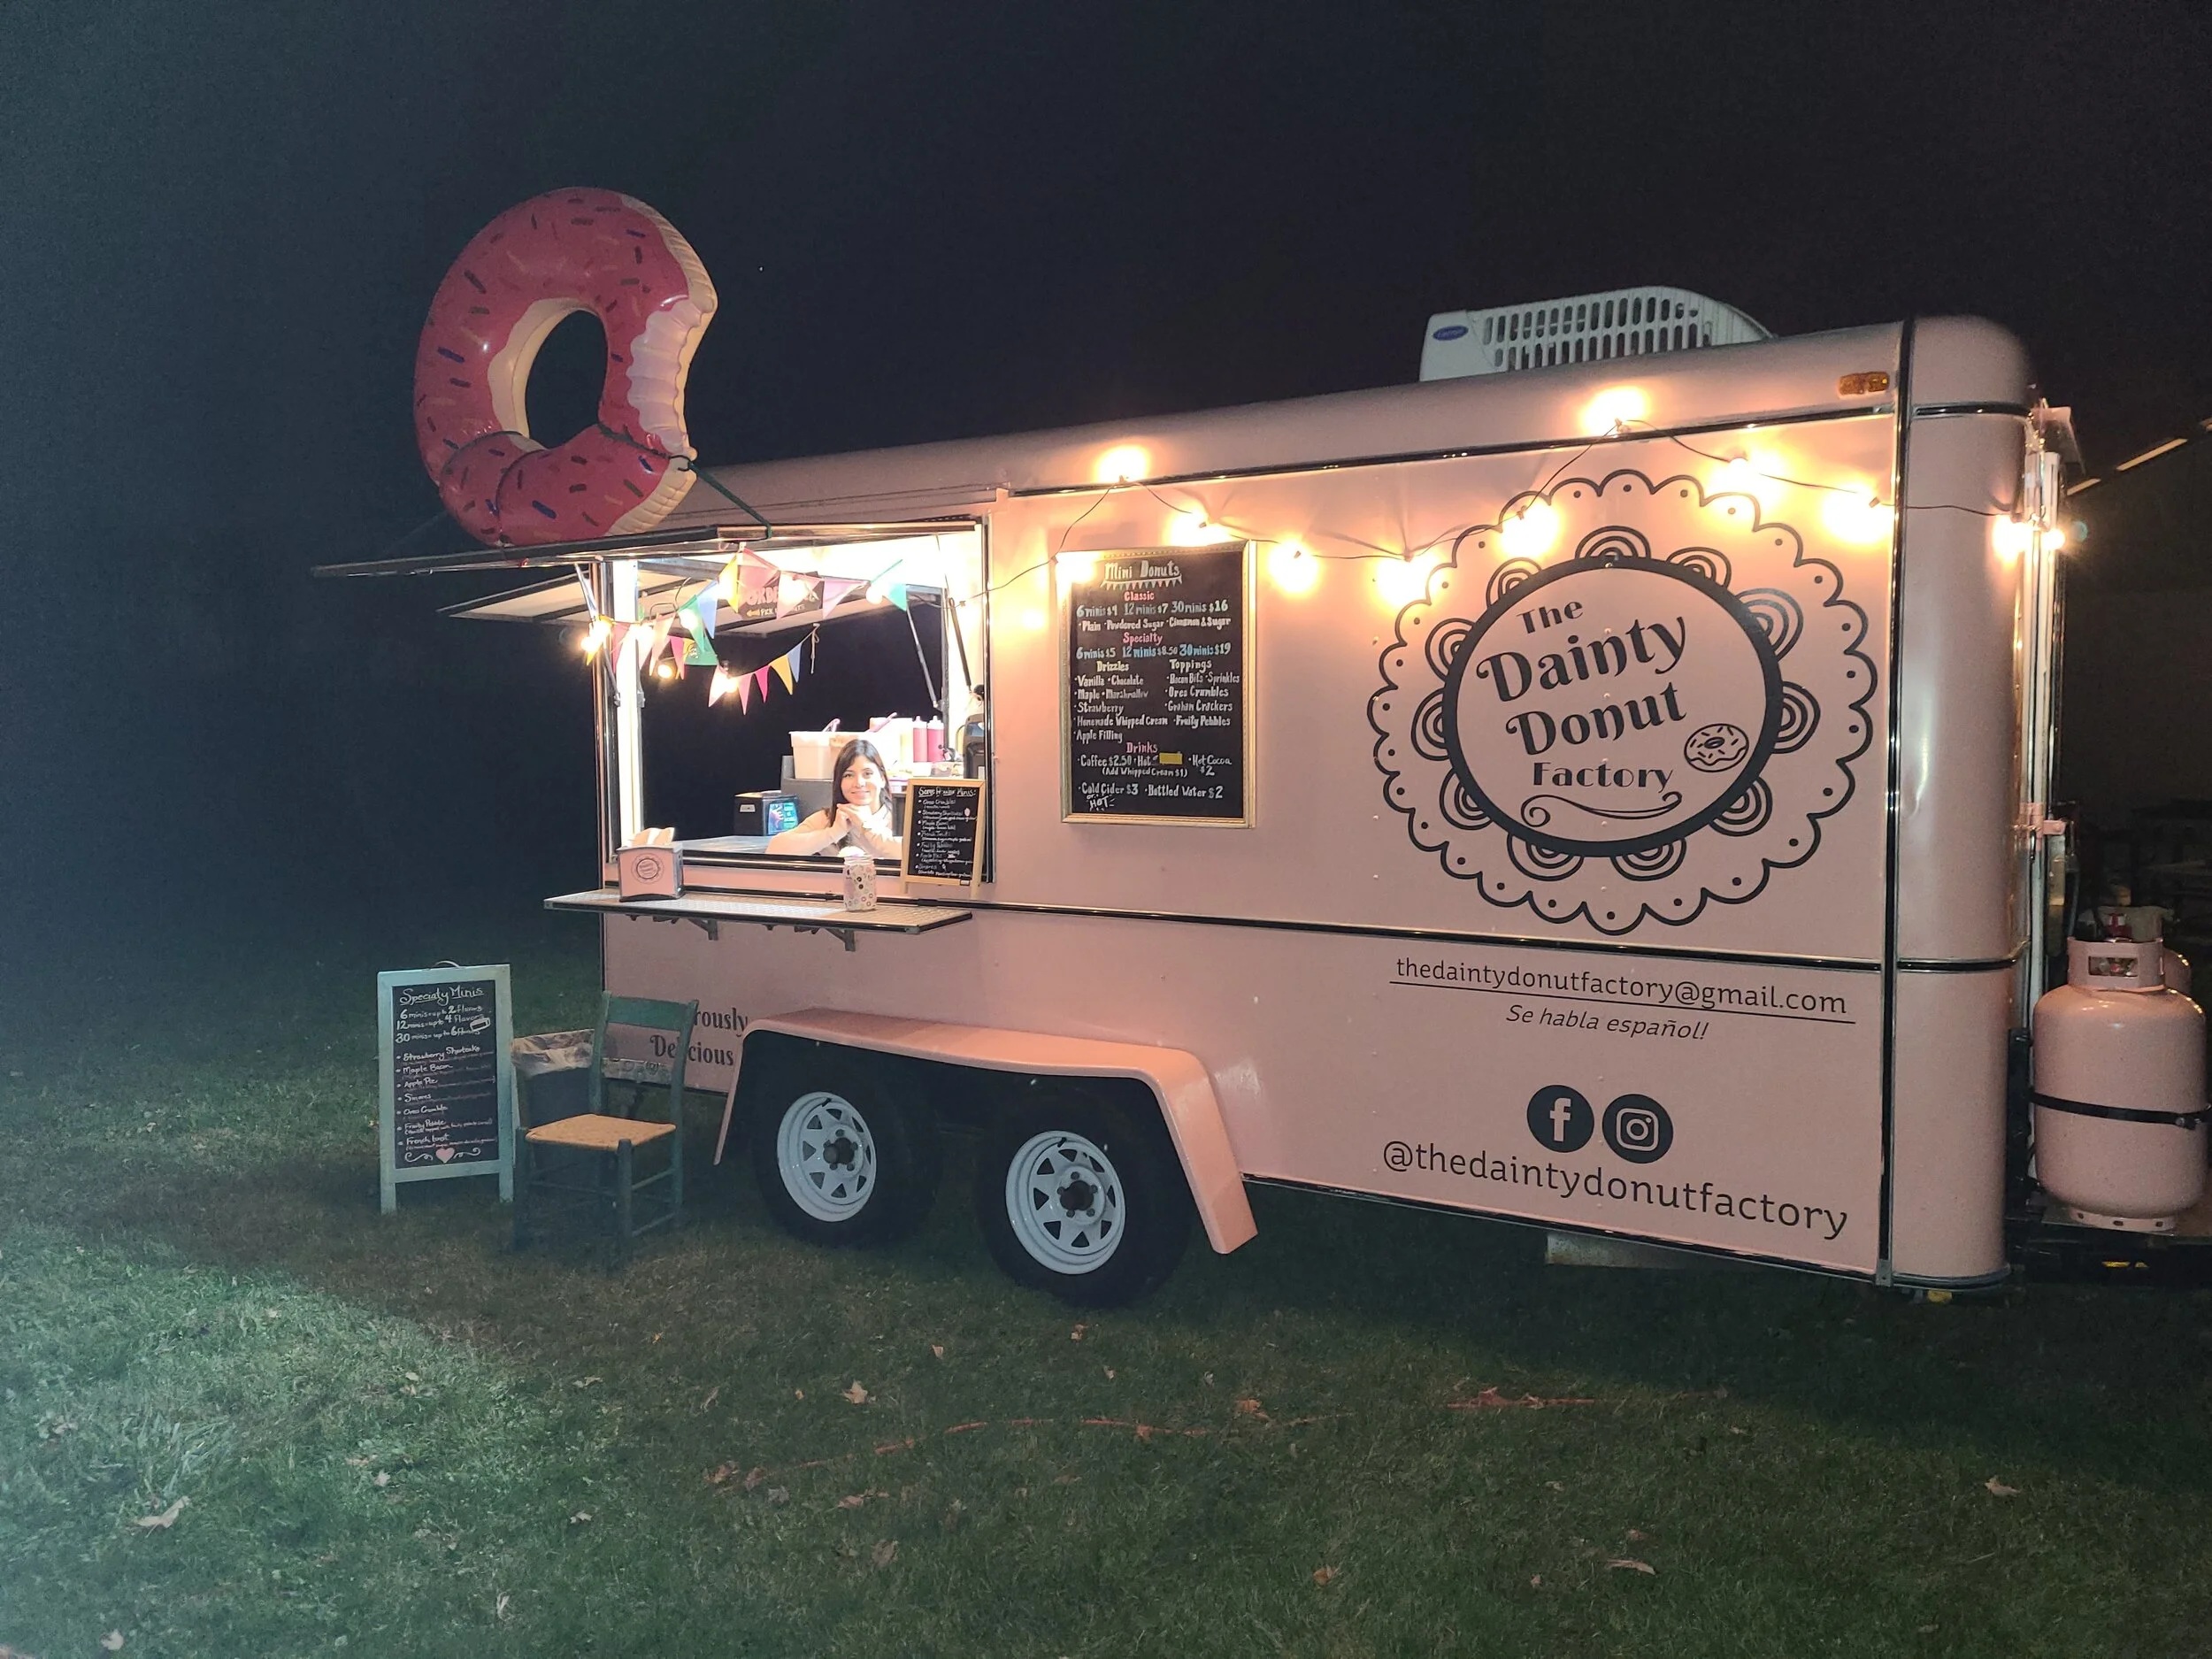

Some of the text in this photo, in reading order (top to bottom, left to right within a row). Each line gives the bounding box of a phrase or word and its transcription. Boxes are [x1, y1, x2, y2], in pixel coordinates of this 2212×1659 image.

[1105, 560, 1180, 580] Mini Donuts
[1124, 591, 1155, 602] Classic
[1209, 599, 1228, 613] $16
[1142, 618, 1164, 631] Sugar
[1207, 617, 1231, 630] Sugar
[1517, 601, 1583, 634] The
[1123, 632, 1163, 646] Specialty
[1214, 641, 1232, 655] $19
[1096, 660, 1129, 672] Drizzles
[1169, 658, 1212, 673] Toppings
[1476, 617, 1686, 703] Dainty
[1077, 674, 1105, 687] Vanilla
[1207, 672, 1240, 686] Sprinkles
[1189, 685, 1229, 697] Crumbles
[1077, 701, 1124, 717] Strawberry
[1195, 699, 1233, 711] Crackers
[1115, 714, 1145, 729] Whipped
[1145, 716, 1168, 726] Cream
[1176, 714, 1231, 729] Fruity Pebbles
[1505, 681, 1686, 756] Donut
[1076, 729, 1123, 744] Apple Filling
[1125, 741, 1158, 754] Drinks
[1080, 755, 1107, 767] Coffee
[1109, 755, 1132, 766] $2.50
[1193, 754, 1233, 766] Hot Cocoa
[1120, 767, 1151, 778] Whipped
[1200, 765, 1216, 776] $2
[1533, 762, 1673, 794] Factory
[1081, 782, 1139, 795] Cold Cider $3
[1148, 784, 1224, 799] Bottled Water $2
[1089, 795, 1109, 809] HOT
[449, 985, 484, 999] Minis
[1396, 957, 1847, 1014] thedaintydonutfactory@gmail.com
[444, 1014, 452, 1023] 4
[1506, 1004, 1709, 1041] Se habla español!
[395, 1033, 411, 1043] 30
[450, 1026, 458, 1035] 6
[649, 1034, 734, 1066] Decious
[403, 1065, 427, 1075] Maple
[1383, 1141, 1847, 1240] @thedaintydonutfactory
